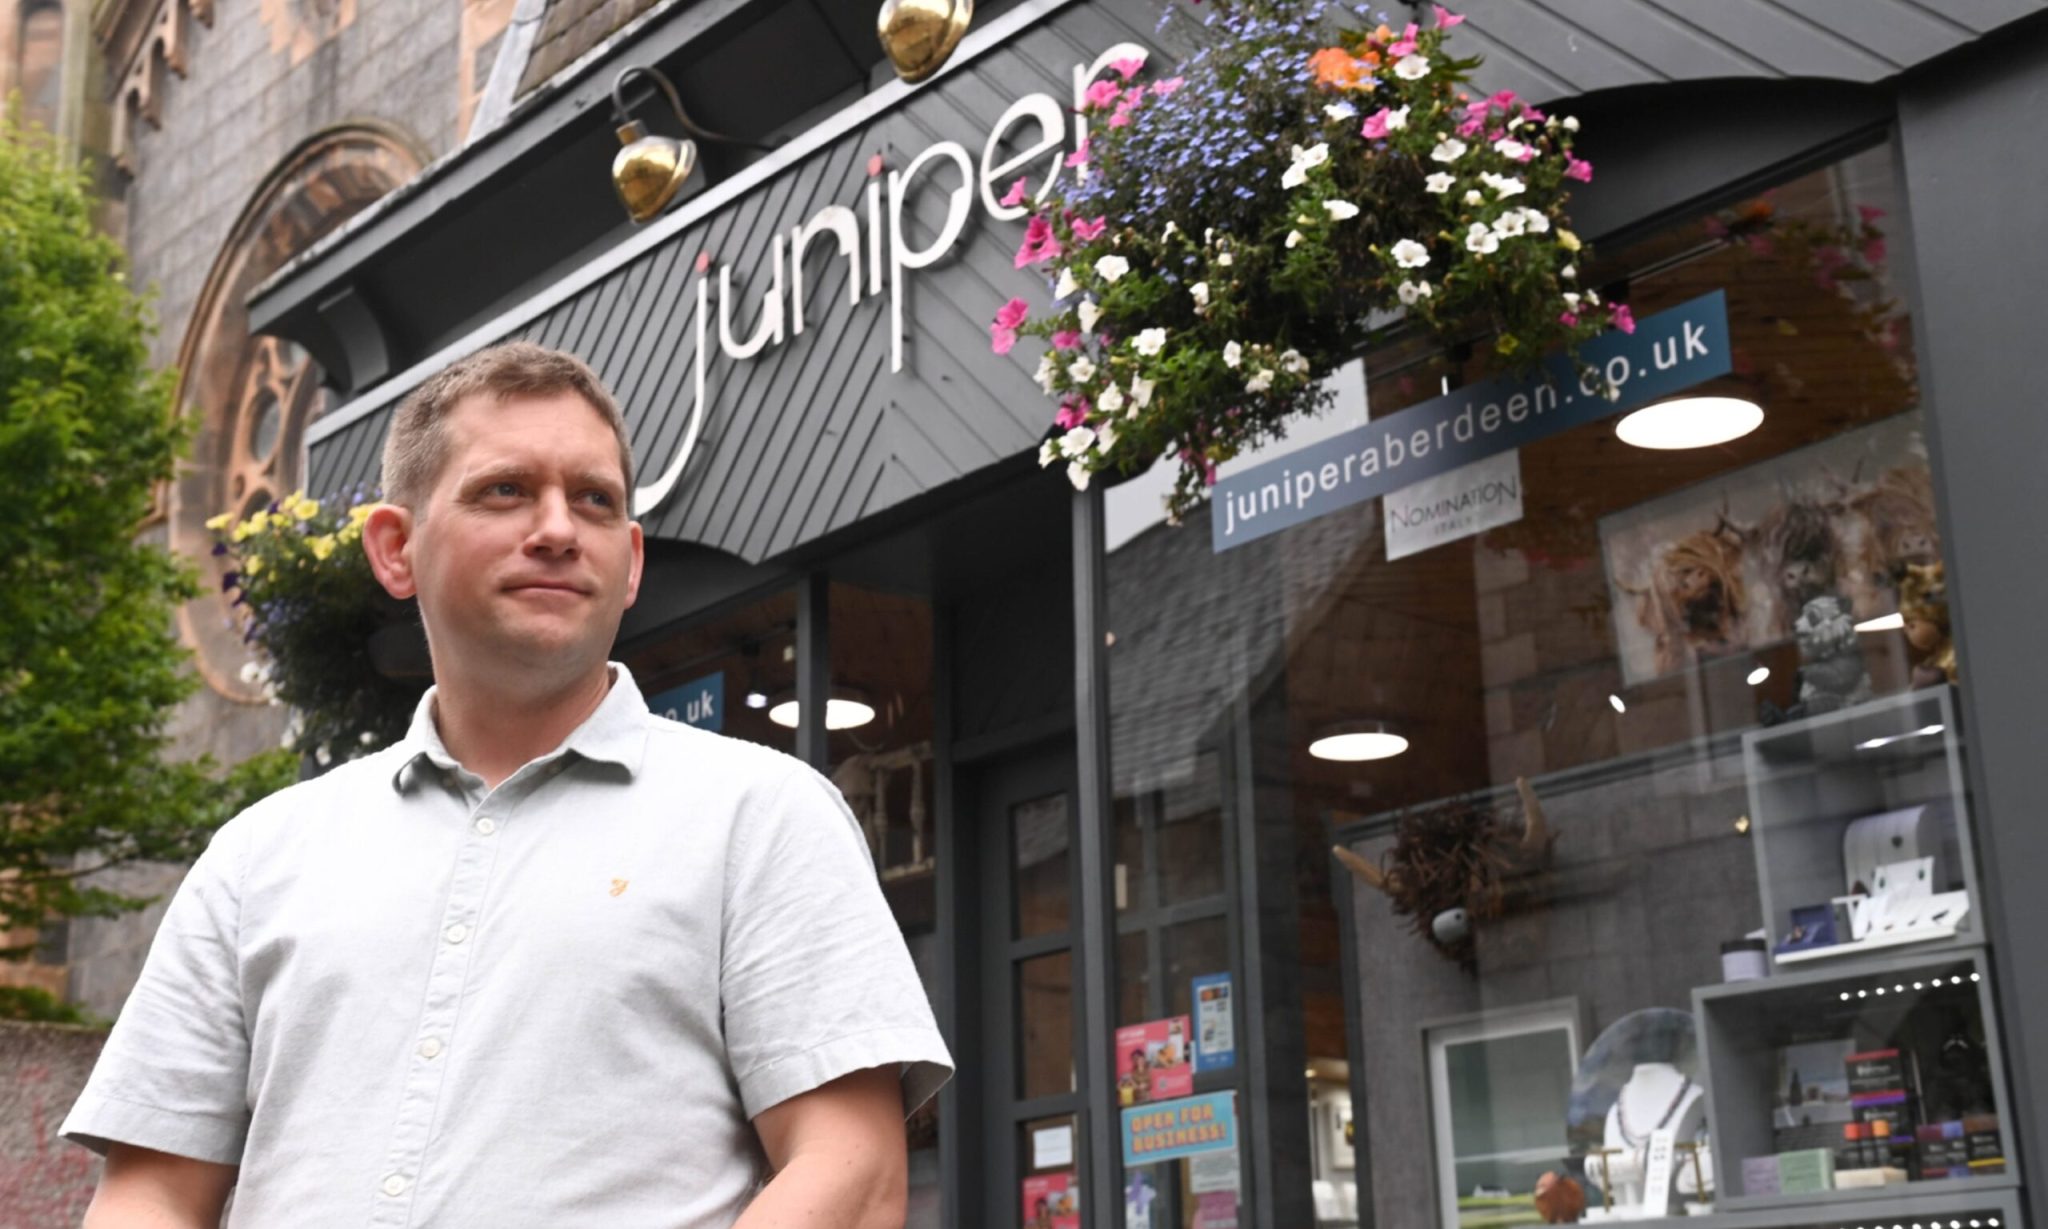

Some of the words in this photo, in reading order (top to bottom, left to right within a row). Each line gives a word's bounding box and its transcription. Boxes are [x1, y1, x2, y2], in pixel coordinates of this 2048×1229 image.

[635, 43, 1149, 517] juniper
[1224, 321, 1709, 535] juniperaberdeen.co.uk
[1131, 1110, 1175, 1134] OPEN
[1180, 1103, 1214, 1124] FOR
[1132, 1121, 1226, 1153] BUSINESS!
